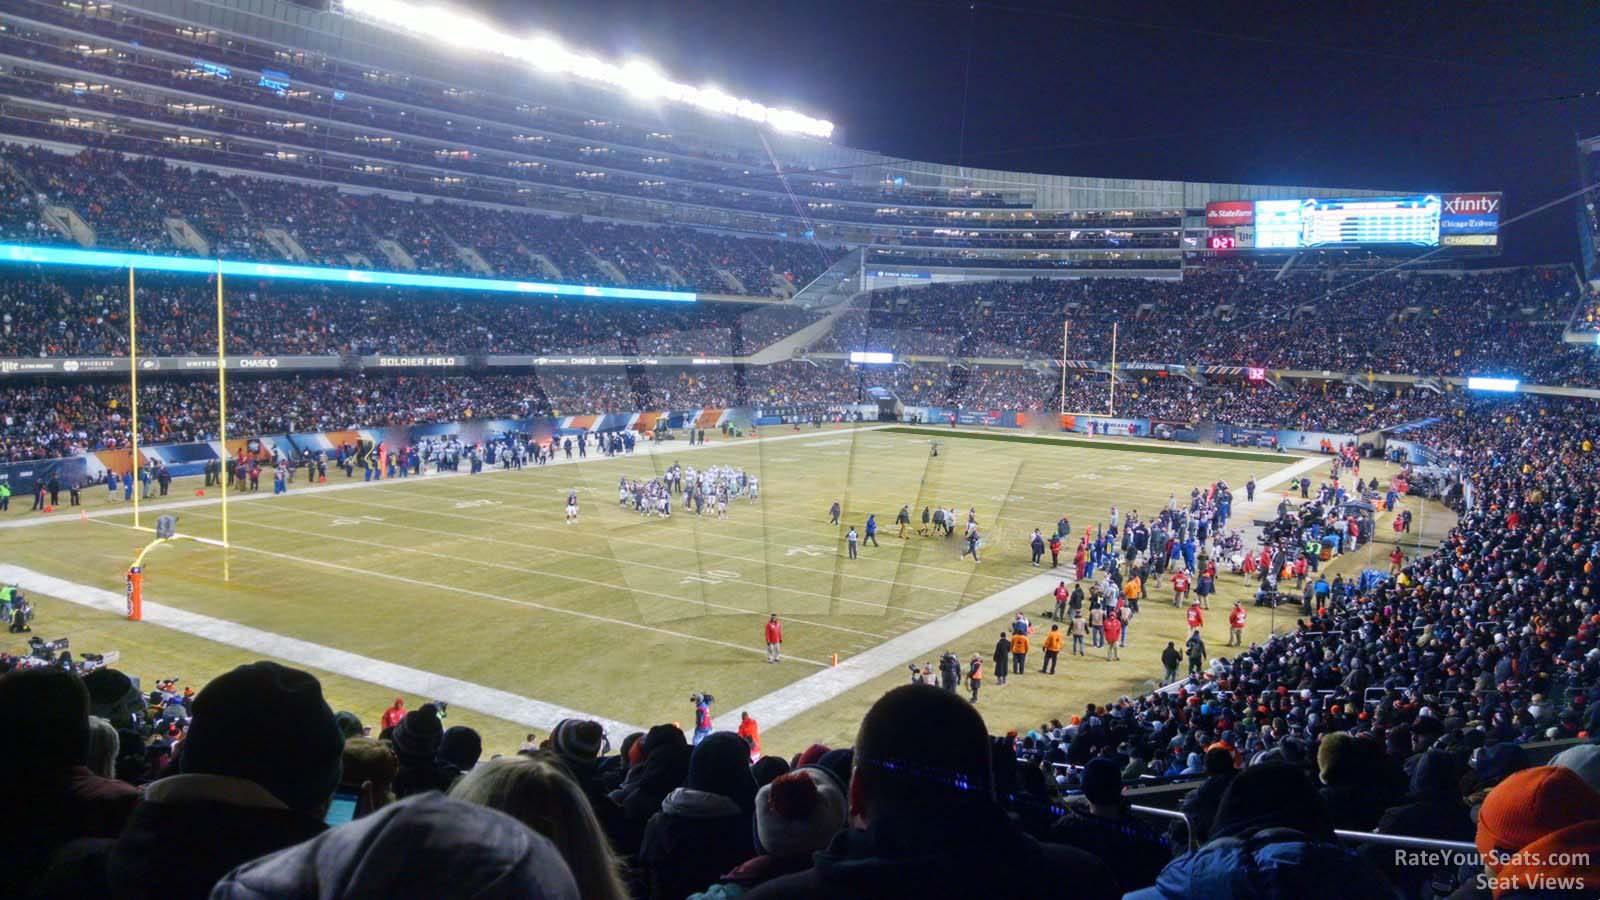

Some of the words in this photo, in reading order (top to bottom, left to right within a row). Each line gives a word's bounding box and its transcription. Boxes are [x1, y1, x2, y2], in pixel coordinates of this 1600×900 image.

[1444, 196, 1498, 214] xfinity
[240, 359, 269, 368] CHASE
[379, 357, 424, 367] SOLDIER
[426, 357, 455, 366] FIELD
